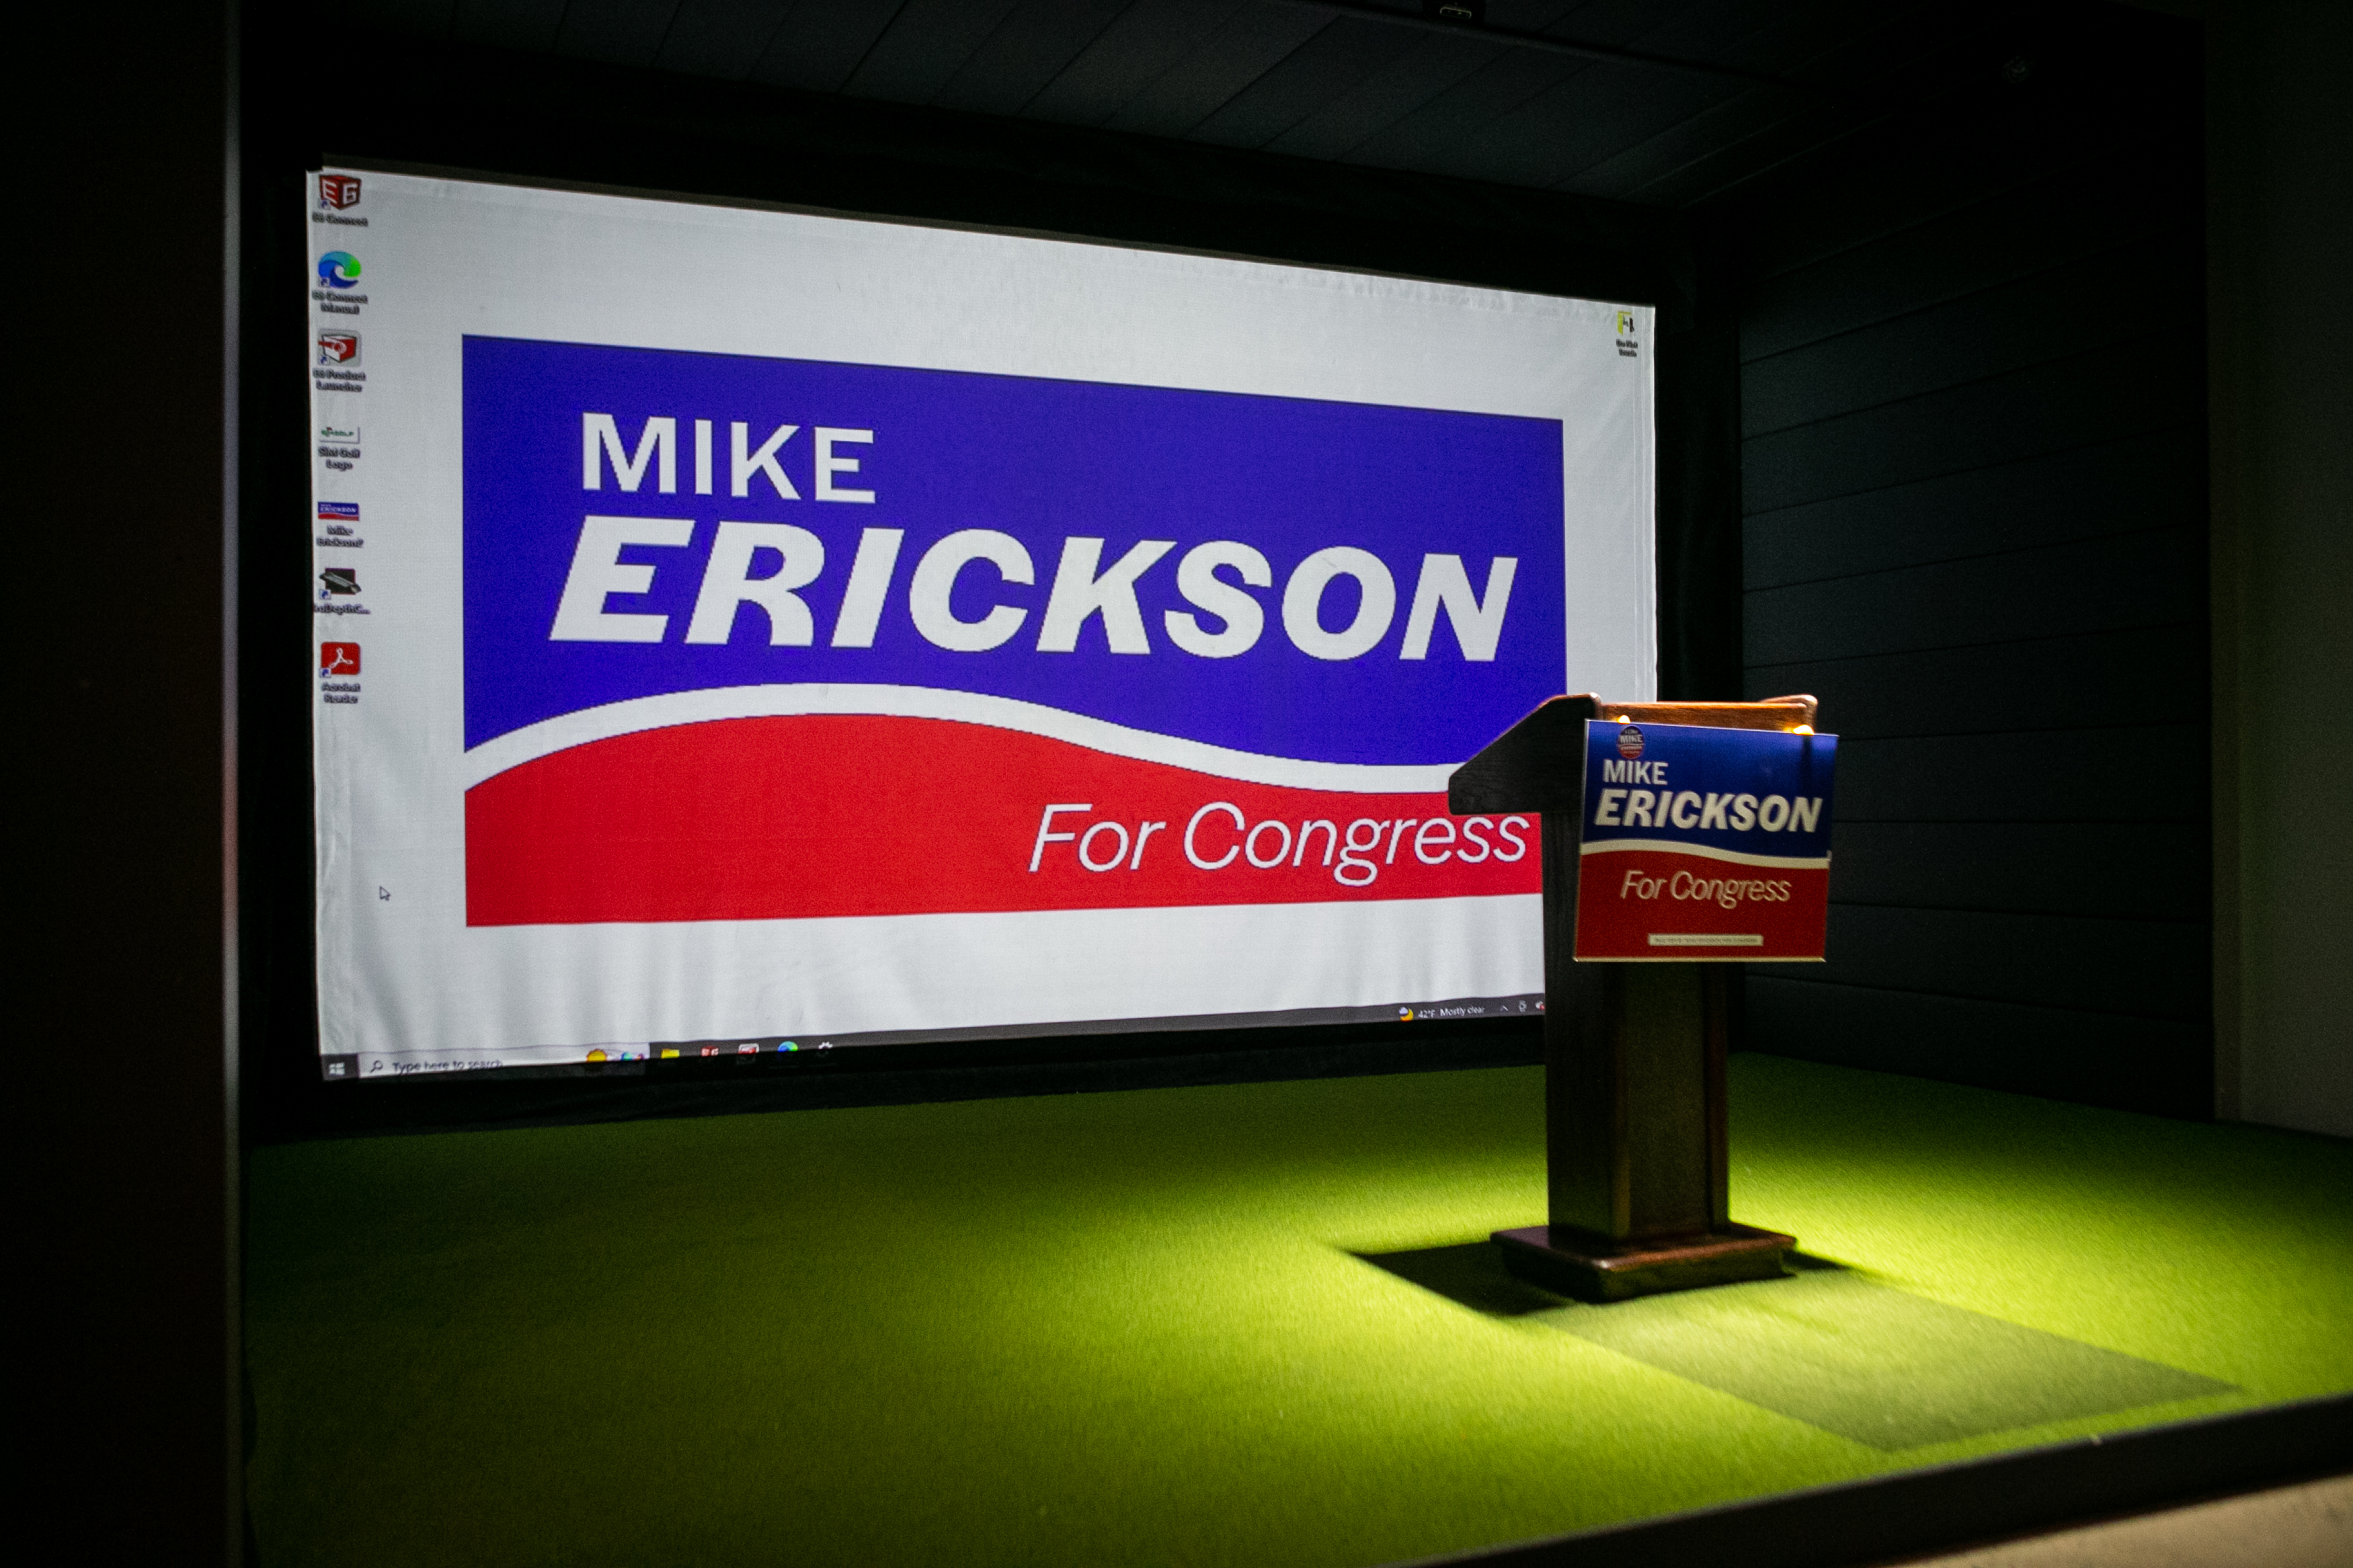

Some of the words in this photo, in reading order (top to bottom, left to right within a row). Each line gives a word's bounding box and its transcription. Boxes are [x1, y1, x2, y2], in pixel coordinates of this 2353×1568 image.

[326, 459, 353, 471] Logo
[582, 411, 876, 504] MIKE
[550, 515, 1519, 662] ERICKSON
[321, 683, 361, 692] Acrobat
[323, 694, 358, 704] Reader
[1620, 735, 1642, 743] MIKE
[1603, 759, 1669, 785] MIKE
[1594, 788, 1823, 833] ERICKSON
[1029, 803, 1166, 873] For
[1183, 801, 1531, 887] Congress
[1620, 869, 1668, 900] For
[1670, 870, 1792, 909] Congress
[1439, 1007, 1466, 1017] Mostly
[393, 1062, 421, 1075] Type
[424, 1061, 449, 1069] here
[453, 1060, 465, 1069] to
[467, 1059, 503, 1069] search
